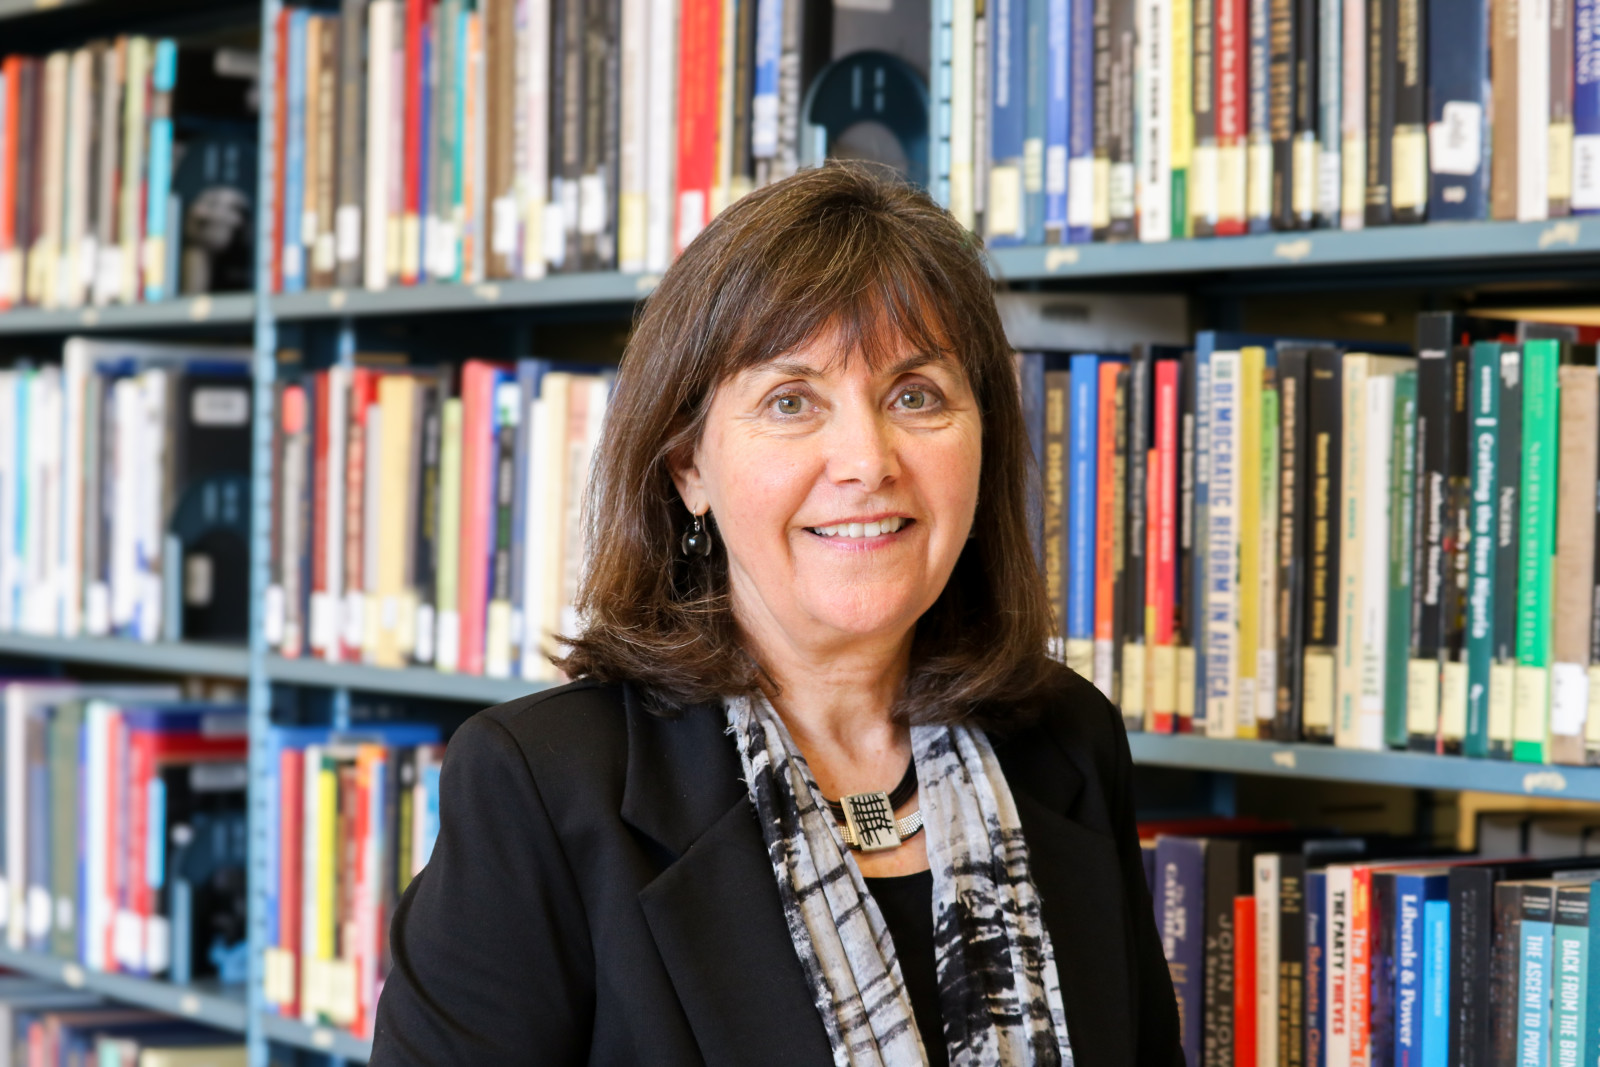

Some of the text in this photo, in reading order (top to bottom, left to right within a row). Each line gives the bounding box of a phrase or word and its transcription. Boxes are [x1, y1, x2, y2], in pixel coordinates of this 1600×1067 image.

[1197, 427, 1208, 450] BIG
[1315, 432, 1329, 475] Human
[1045, 442, 1062, 527] DIGITAL
[1181, 452, 1193, 490] Security
[1197, 454, 1208, 483] MEN
[1280, 378, 1296, 567] DEMOCRACY IN BLACK AFRICA
[1473, 433, 1493, 498] Crafting
[1313, 478, 1329, 517] Rights
[1476, 506, 1491, 533] the
[1209, 384, 1232, 698] DEMOCRATIC REFORM IN AFRICA
[1425, 473, 1442, 605] Authority Stealing
[1475, 537, 1491, 574] New
[1314, 556, 1327, 568] in
[1313, 570, 1327, 598] East
[1312, 601, 1326, 640] Africa
[1472, 577, 1491, 638] Nigeria
[1207, 937, 1217, 949] A
[1352, 928, 1366, 957] The
[1526, 936, 1543, 957] THE
[1562, 940, 1580, 972] BACK
[1207, 956, 1217, 1004] Sense
[1306, 946, 1321, 1012] Subjects
[1333, 891, 1345, 1035] THE PARTY THIEVES
[1399, 894, 1417, 1047] Liberals & Power
[1218, 914, 1232, 1067] JOHN HOW
[1525, 961, 1542, 1009] ASCENT
[1560, 976, 1579, 1011] FROM
[1206, 1012, 1217, 1030] of
[1351, 963, 1366, 1050] Australian
[1525, 1013, 1541, 1027] TO
[1560, 1015, 1578, 1037] THE
[1523, 1030, 1540, 1067] POWE
